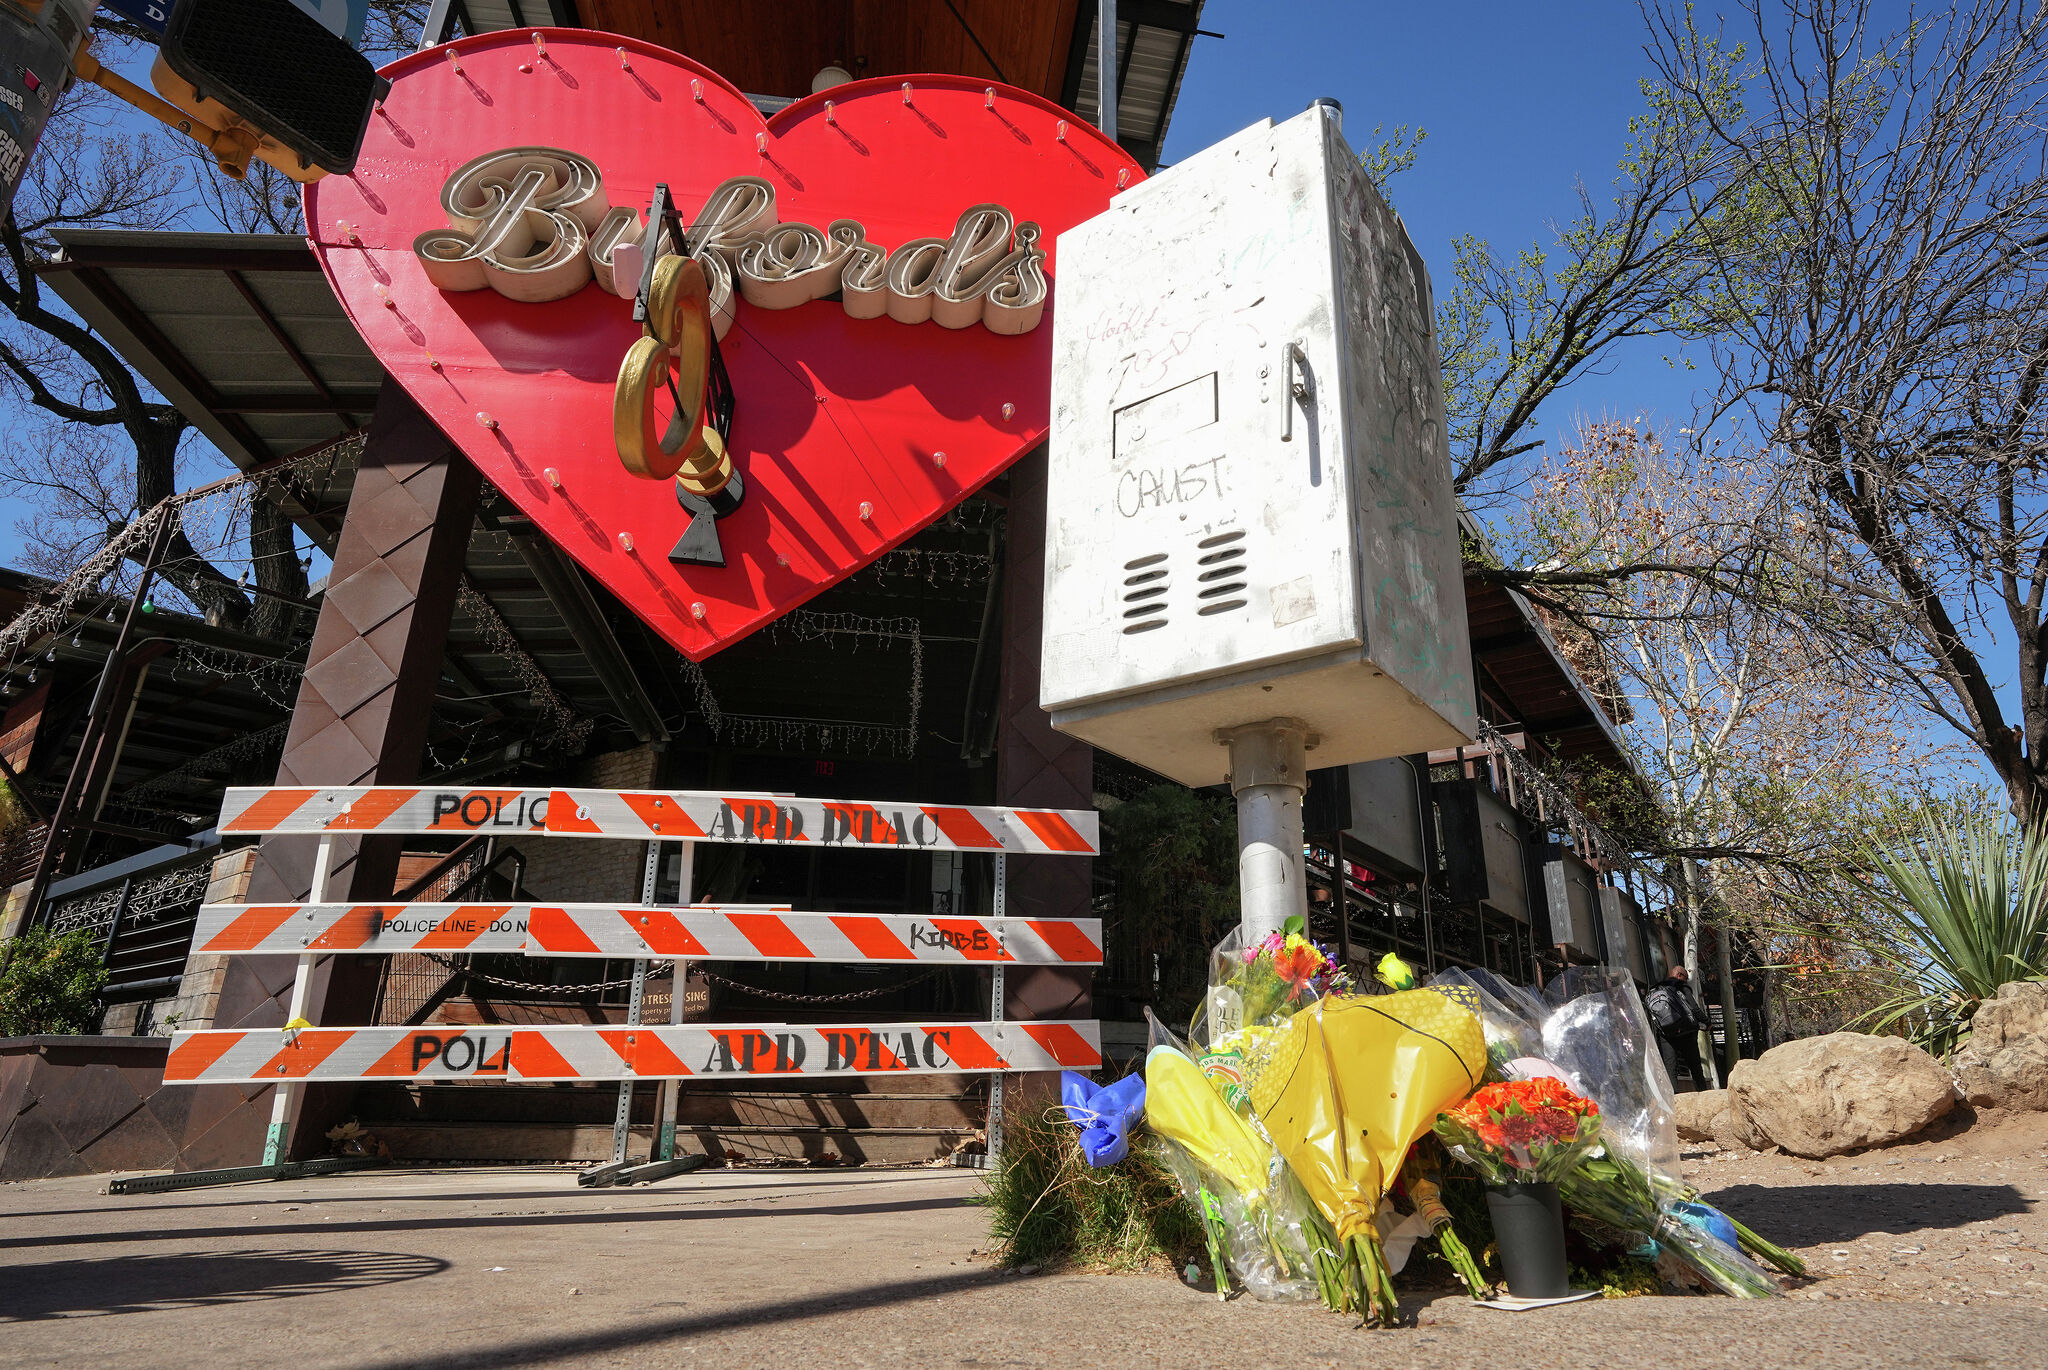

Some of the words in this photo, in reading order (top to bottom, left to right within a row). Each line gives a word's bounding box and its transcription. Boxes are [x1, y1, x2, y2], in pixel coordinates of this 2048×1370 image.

[433, 794, 550, 827] POLIC
[705, 803, 804, 844] APD
[822, 807, 939, 848] DTAC
[381, 919, 438, 933] POLICE
[442, 919, 476, 932] LINE
[489, 920, 513, 932] DO
[648, 991, 707, 1006] TRESPSING
[412, 1035, 512, 1072] POLI
[701, 1033, 806, 1073] APD
[824, 1031, 951, 1071] DTAC
